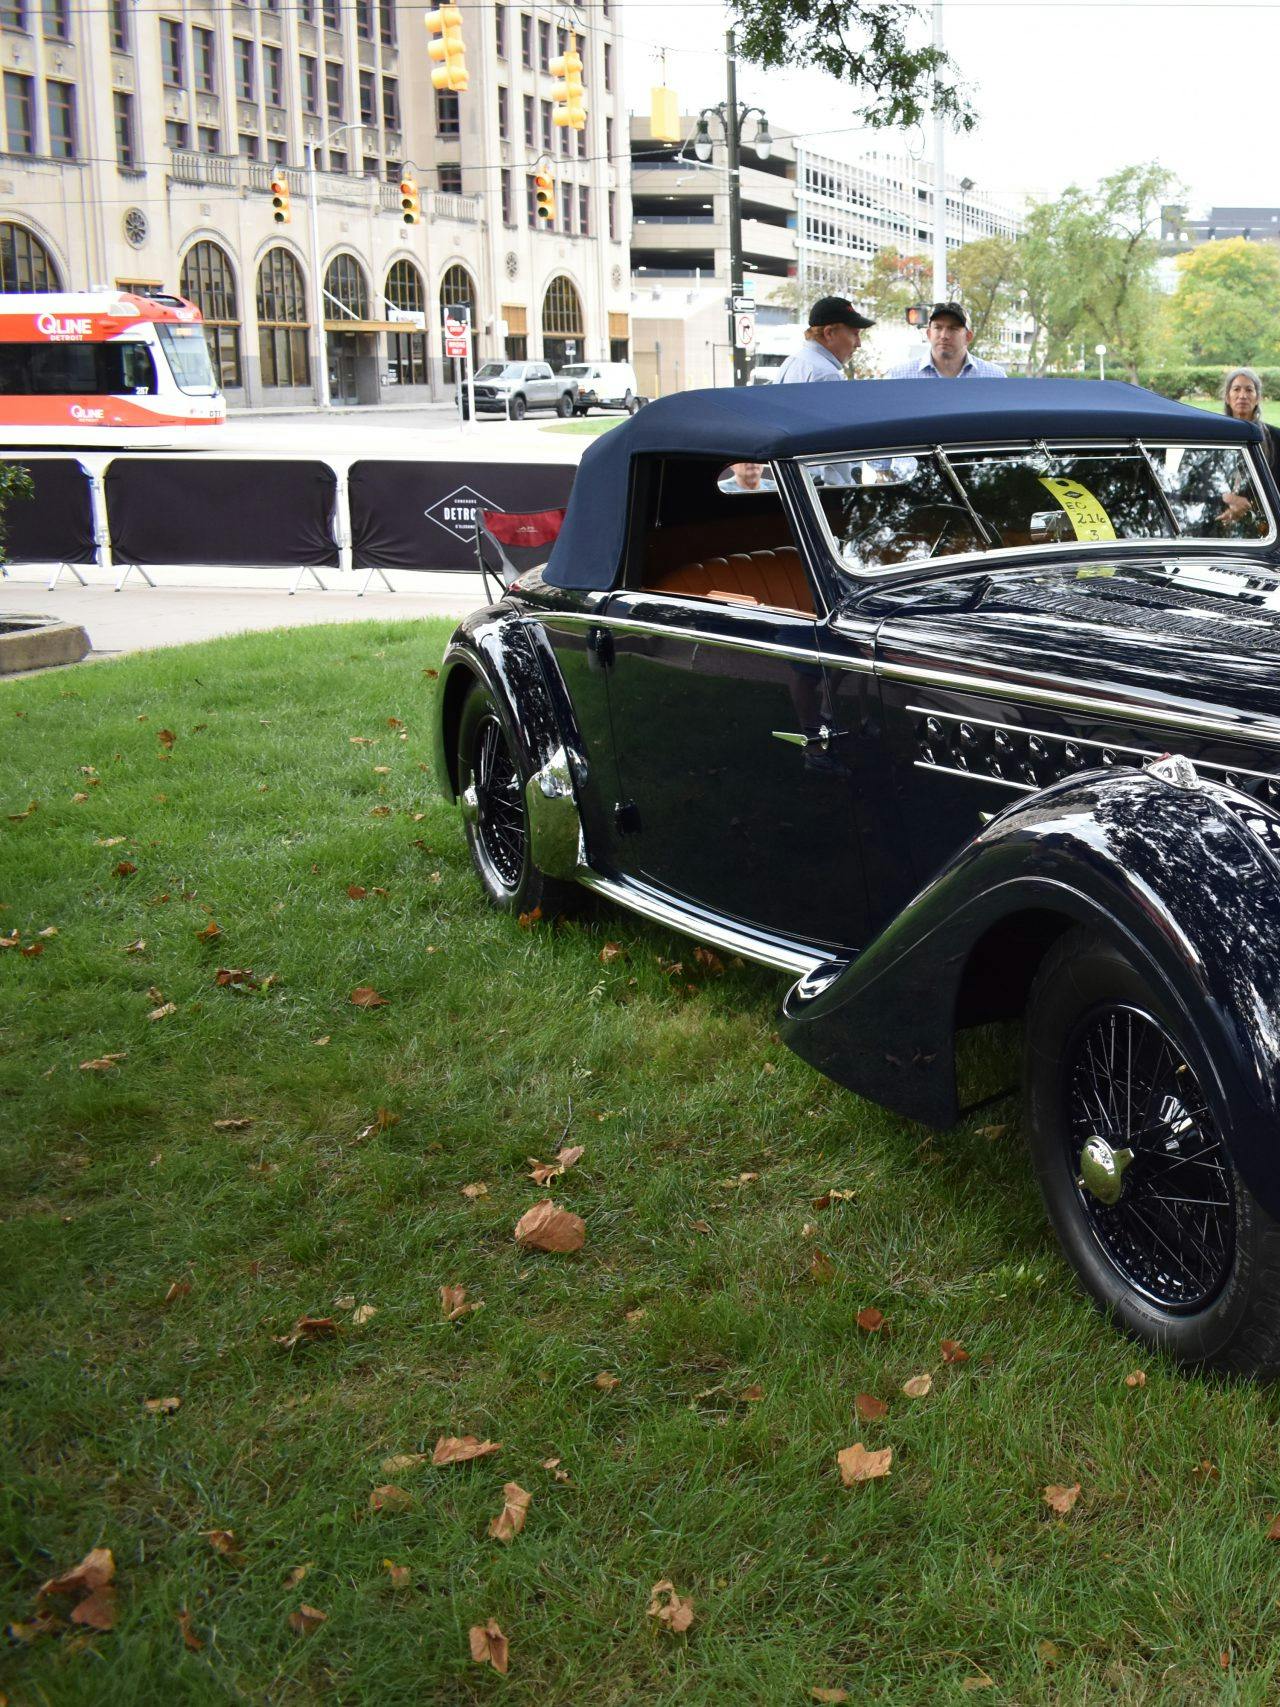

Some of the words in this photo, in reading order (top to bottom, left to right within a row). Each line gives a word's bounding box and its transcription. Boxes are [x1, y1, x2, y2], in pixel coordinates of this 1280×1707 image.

[444, 507, 477, 521] DETRO
[1076, 512, 1107, 524] 216
[1090, 529, 1100, 541] 3
